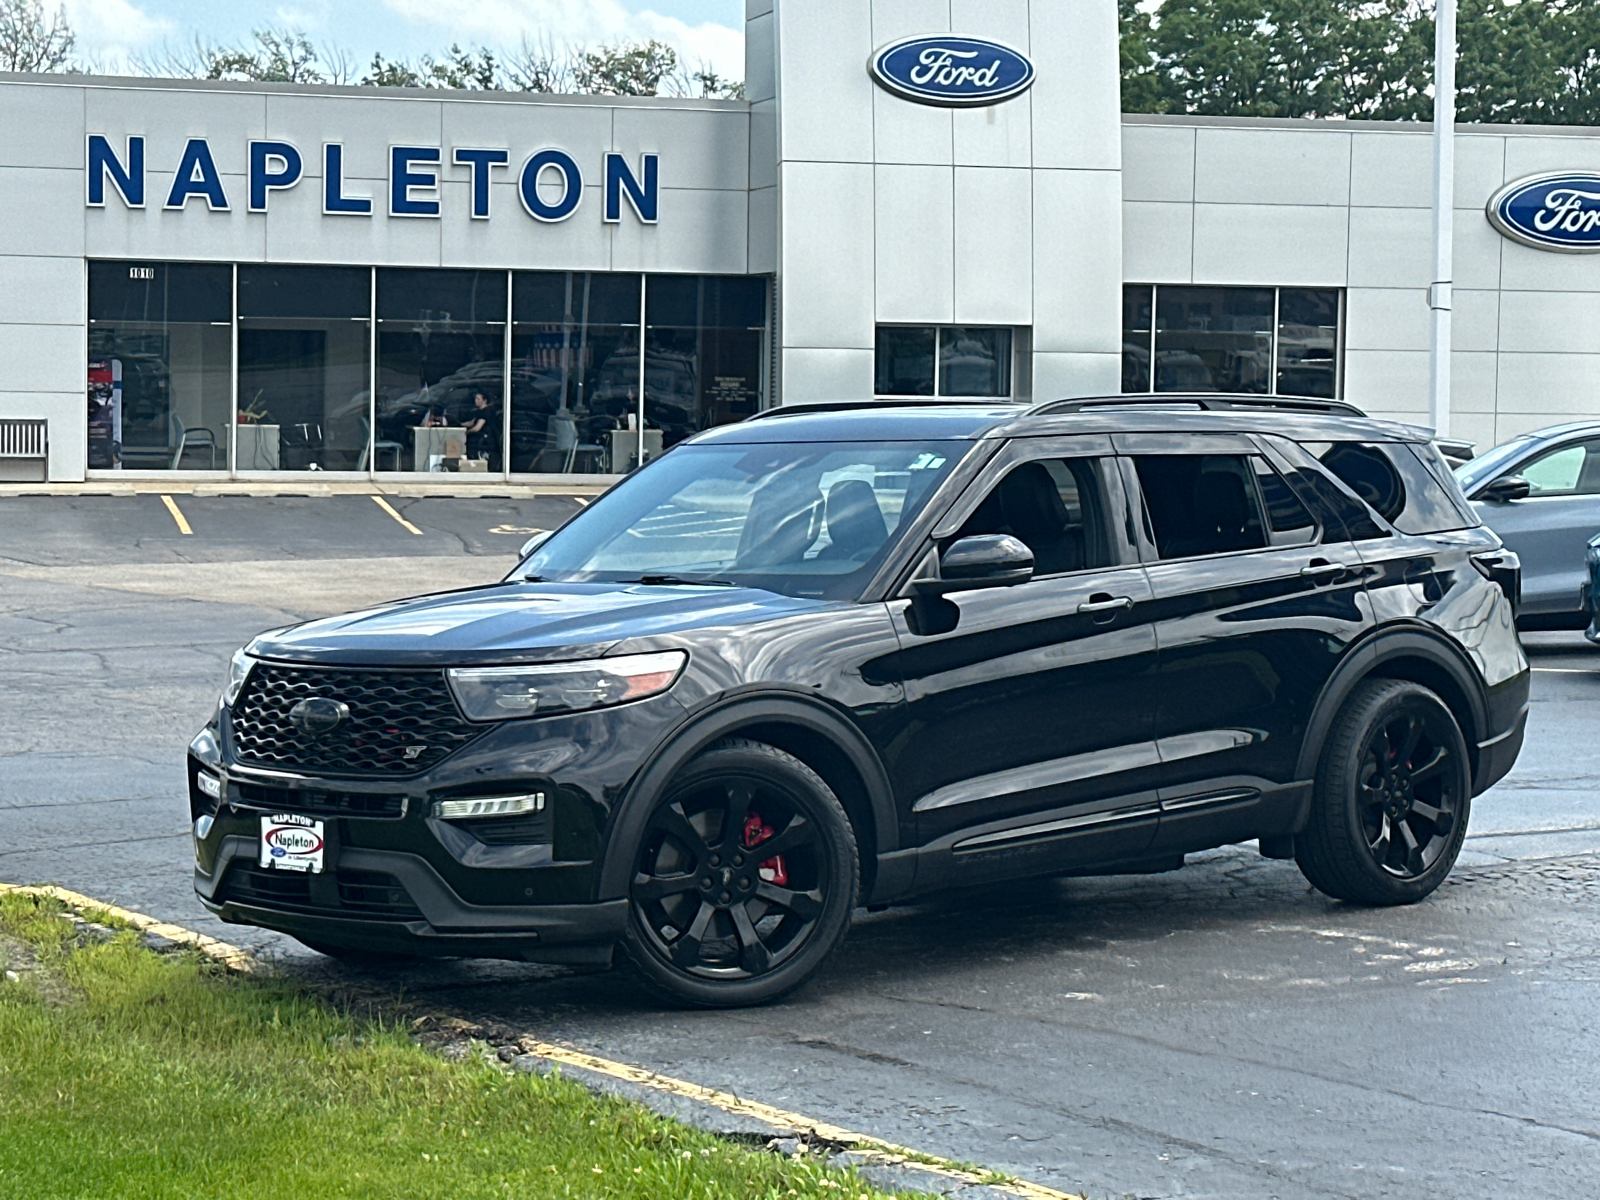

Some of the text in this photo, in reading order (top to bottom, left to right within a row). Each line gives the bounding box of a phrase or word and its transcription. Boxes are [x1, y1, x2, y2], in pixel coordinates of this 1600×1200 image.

[909, 47, 1001, 87] Ford
[85, 133, 660, 225] NAPLETON
[1533, 188, 1600, 232] For
[129, 266, 155, 280] 1010
[272, 813, 314, 828] NAPLETON
[275, 831, 314, 849] Napleton
